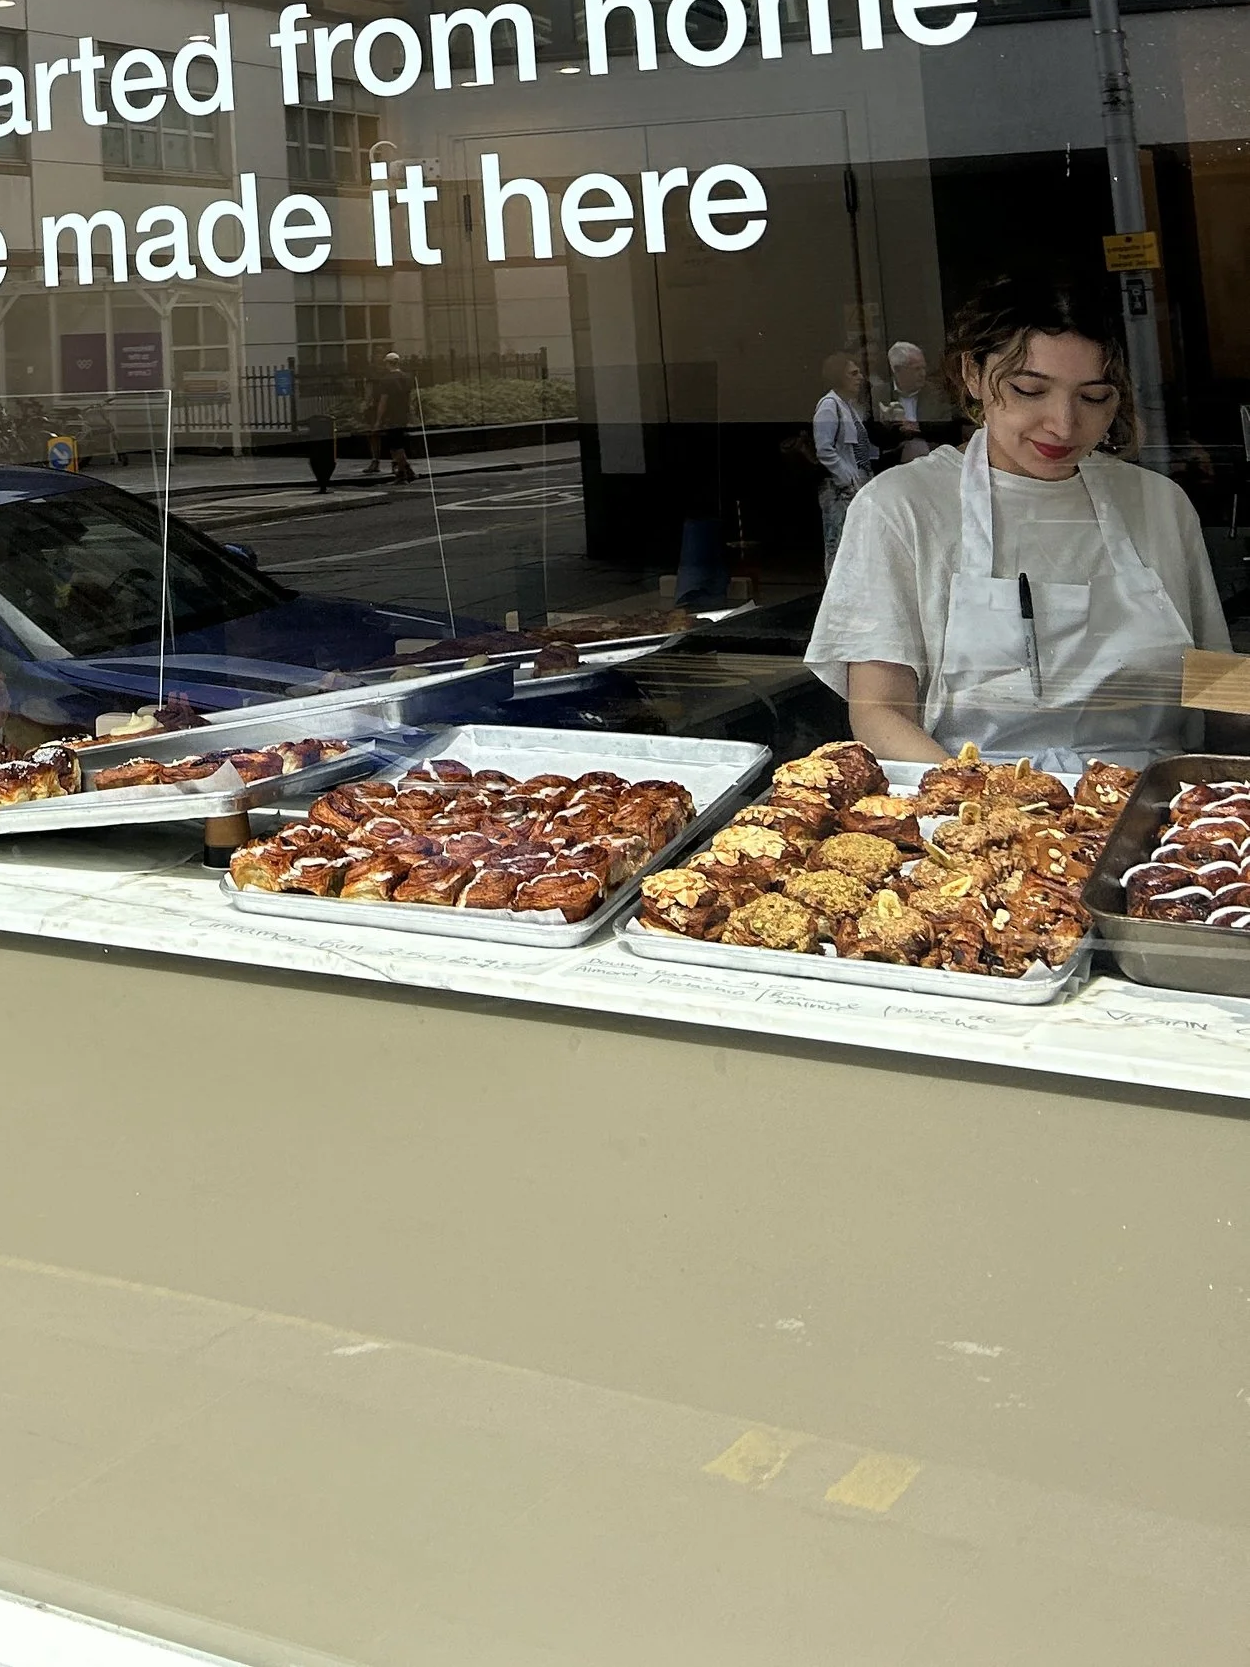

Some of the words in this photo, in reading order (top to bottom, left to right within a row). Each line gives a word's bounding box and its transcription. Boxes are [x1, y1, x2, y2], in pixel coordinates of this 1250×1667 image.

[270, 3, 538, 105] from
[44, 172, 332, 287] made
[371, 162, 442, 267] it
[481, 153, 768, 262] here
[319, 938, 364, 952] Bun
